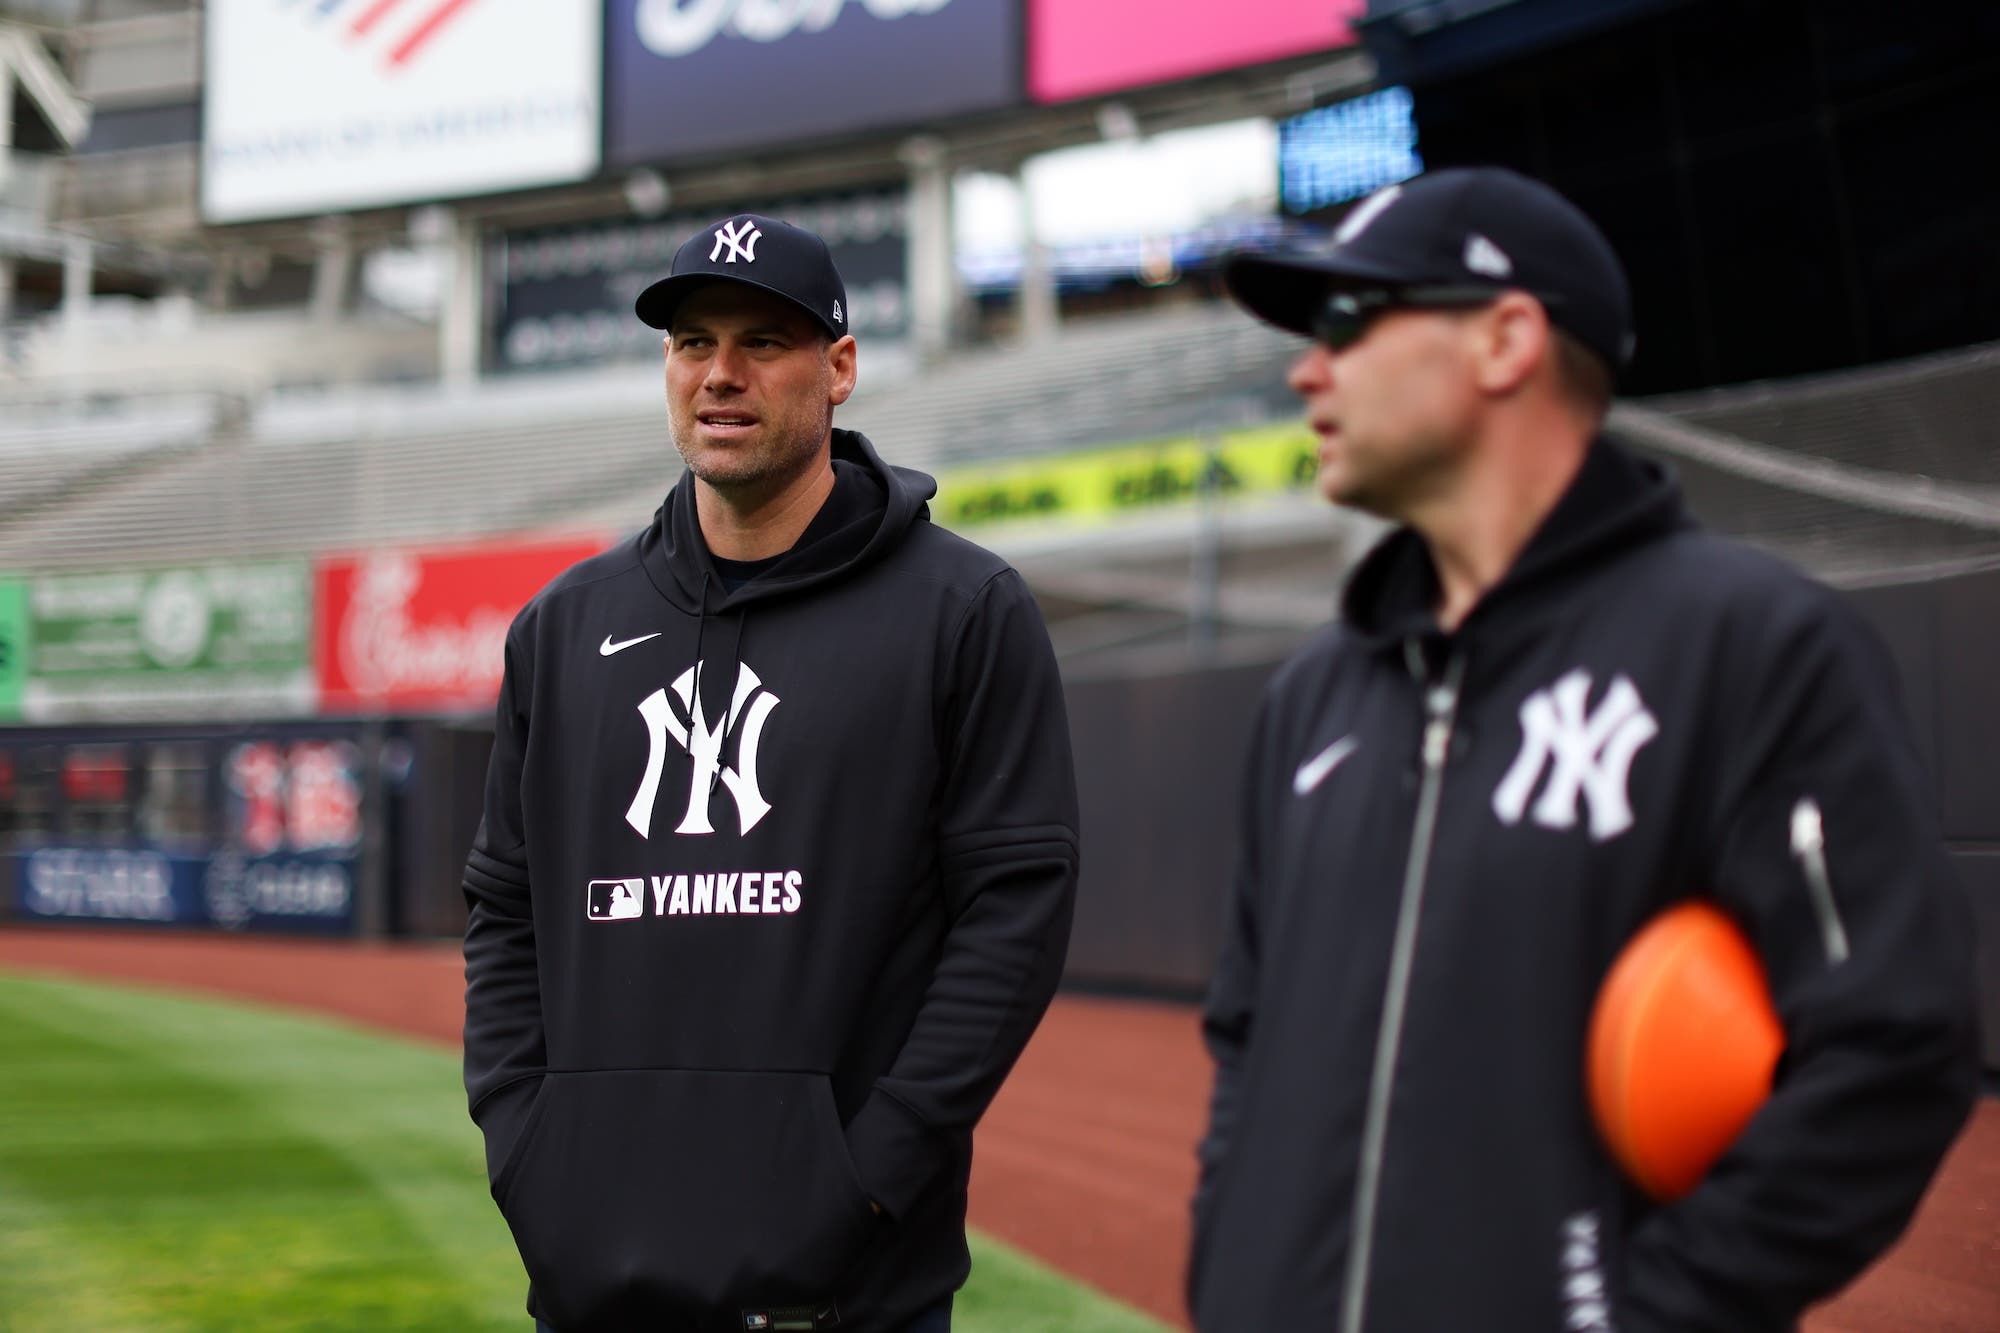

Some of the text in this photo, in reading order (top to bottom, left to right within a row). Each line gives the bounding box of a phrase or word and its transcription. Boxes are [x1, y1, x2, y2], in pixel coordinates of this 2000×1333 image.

[708, 220, 763, 263] NY
[625, 659, 781, 839] NY
[1492, 667, 1658, 839] NY
[651, 869, 803, 916] YANKEES
[1561, 1211, 1610, 1333] YANK
